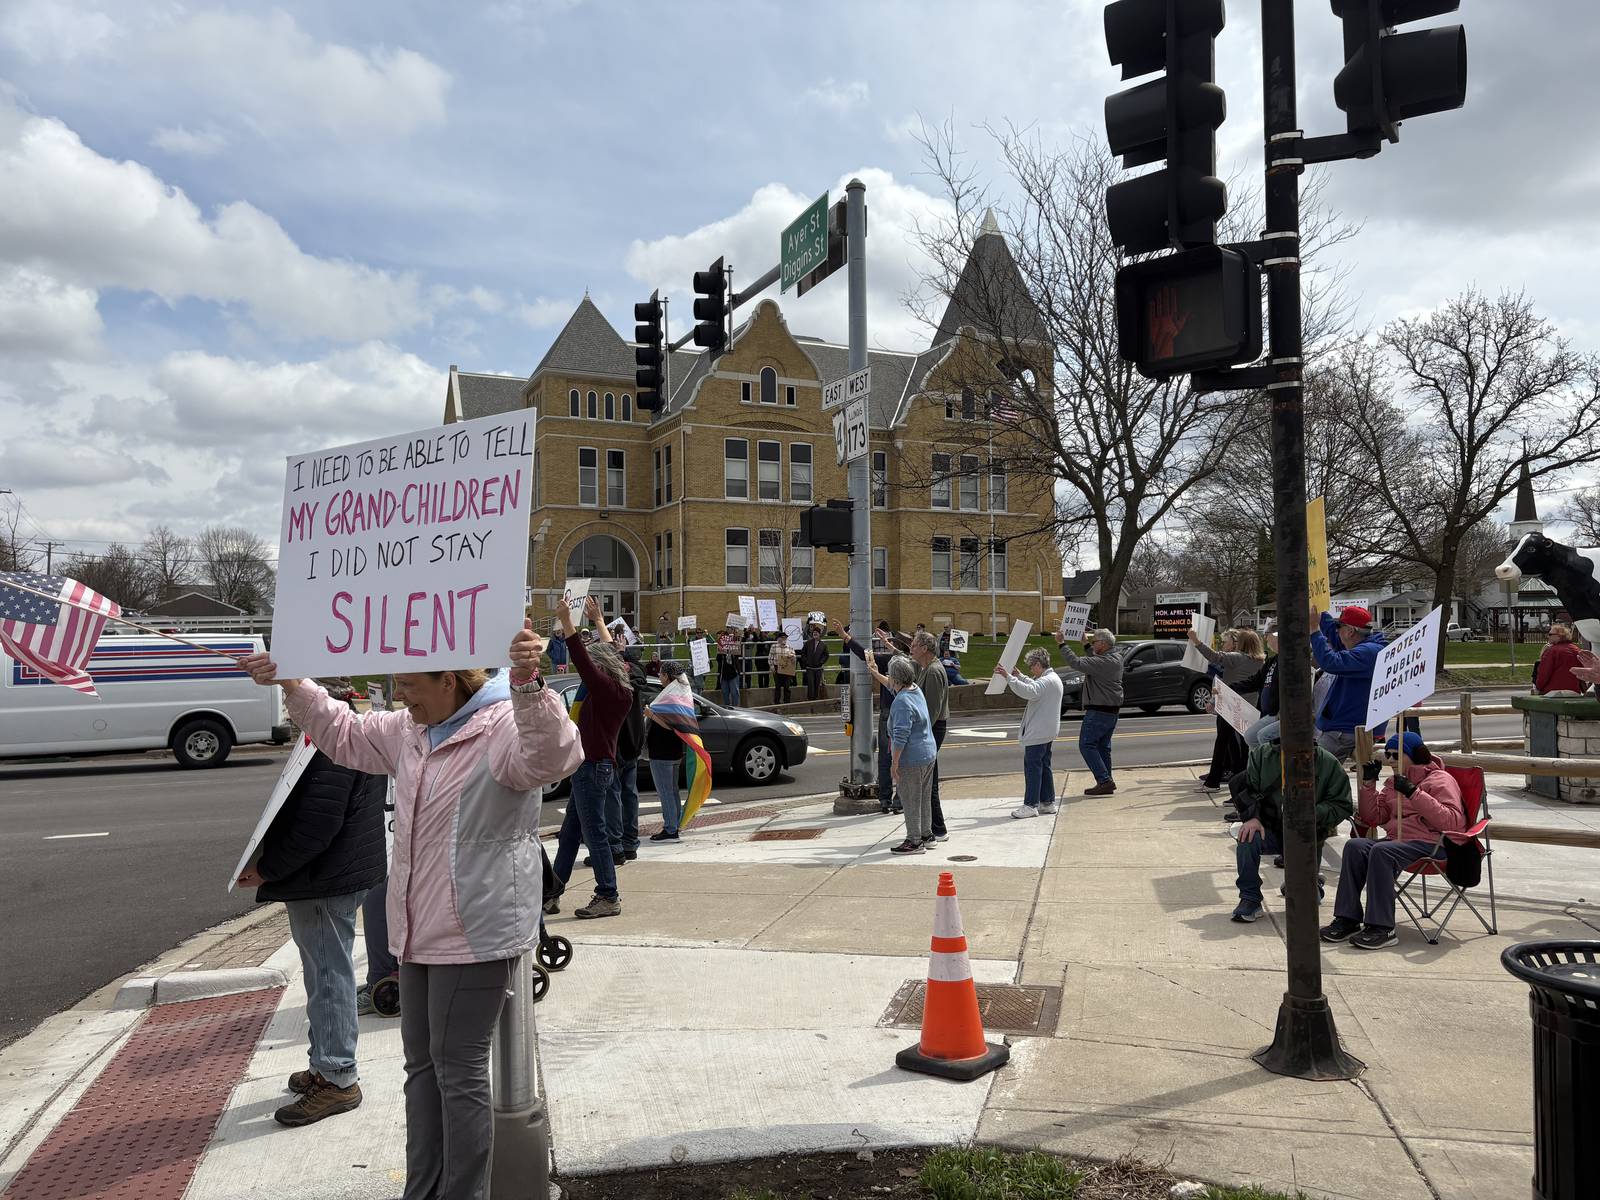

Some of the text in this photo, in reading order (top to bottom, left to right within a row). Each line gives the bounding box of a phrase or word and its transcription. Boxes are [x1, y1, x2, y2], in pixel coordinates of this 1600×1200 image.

[788, 210, 820, 254] Ayer St
[784, 234, 824, 281] Diggins St
[825, 384, 842, 404] EAST
[849, 373, 869, 395] WEST
[293, 422, 533, 492] I NEED TO BE ABLE TO TELL
[847, 422, 866, 453] 173
[288, 501, 319, 543] MY
[307, 530, 492, 580] I DID NOT STAY
[326, 584, 489, 656] SILENT
[1067, 605, 1088, 614] TYRANNY
[1384, 625, 1428, 663] PROTECT
[1386, 647, 1422, 679] PUBLIC
[1373, 660, 1426, 701] EDUCATION
